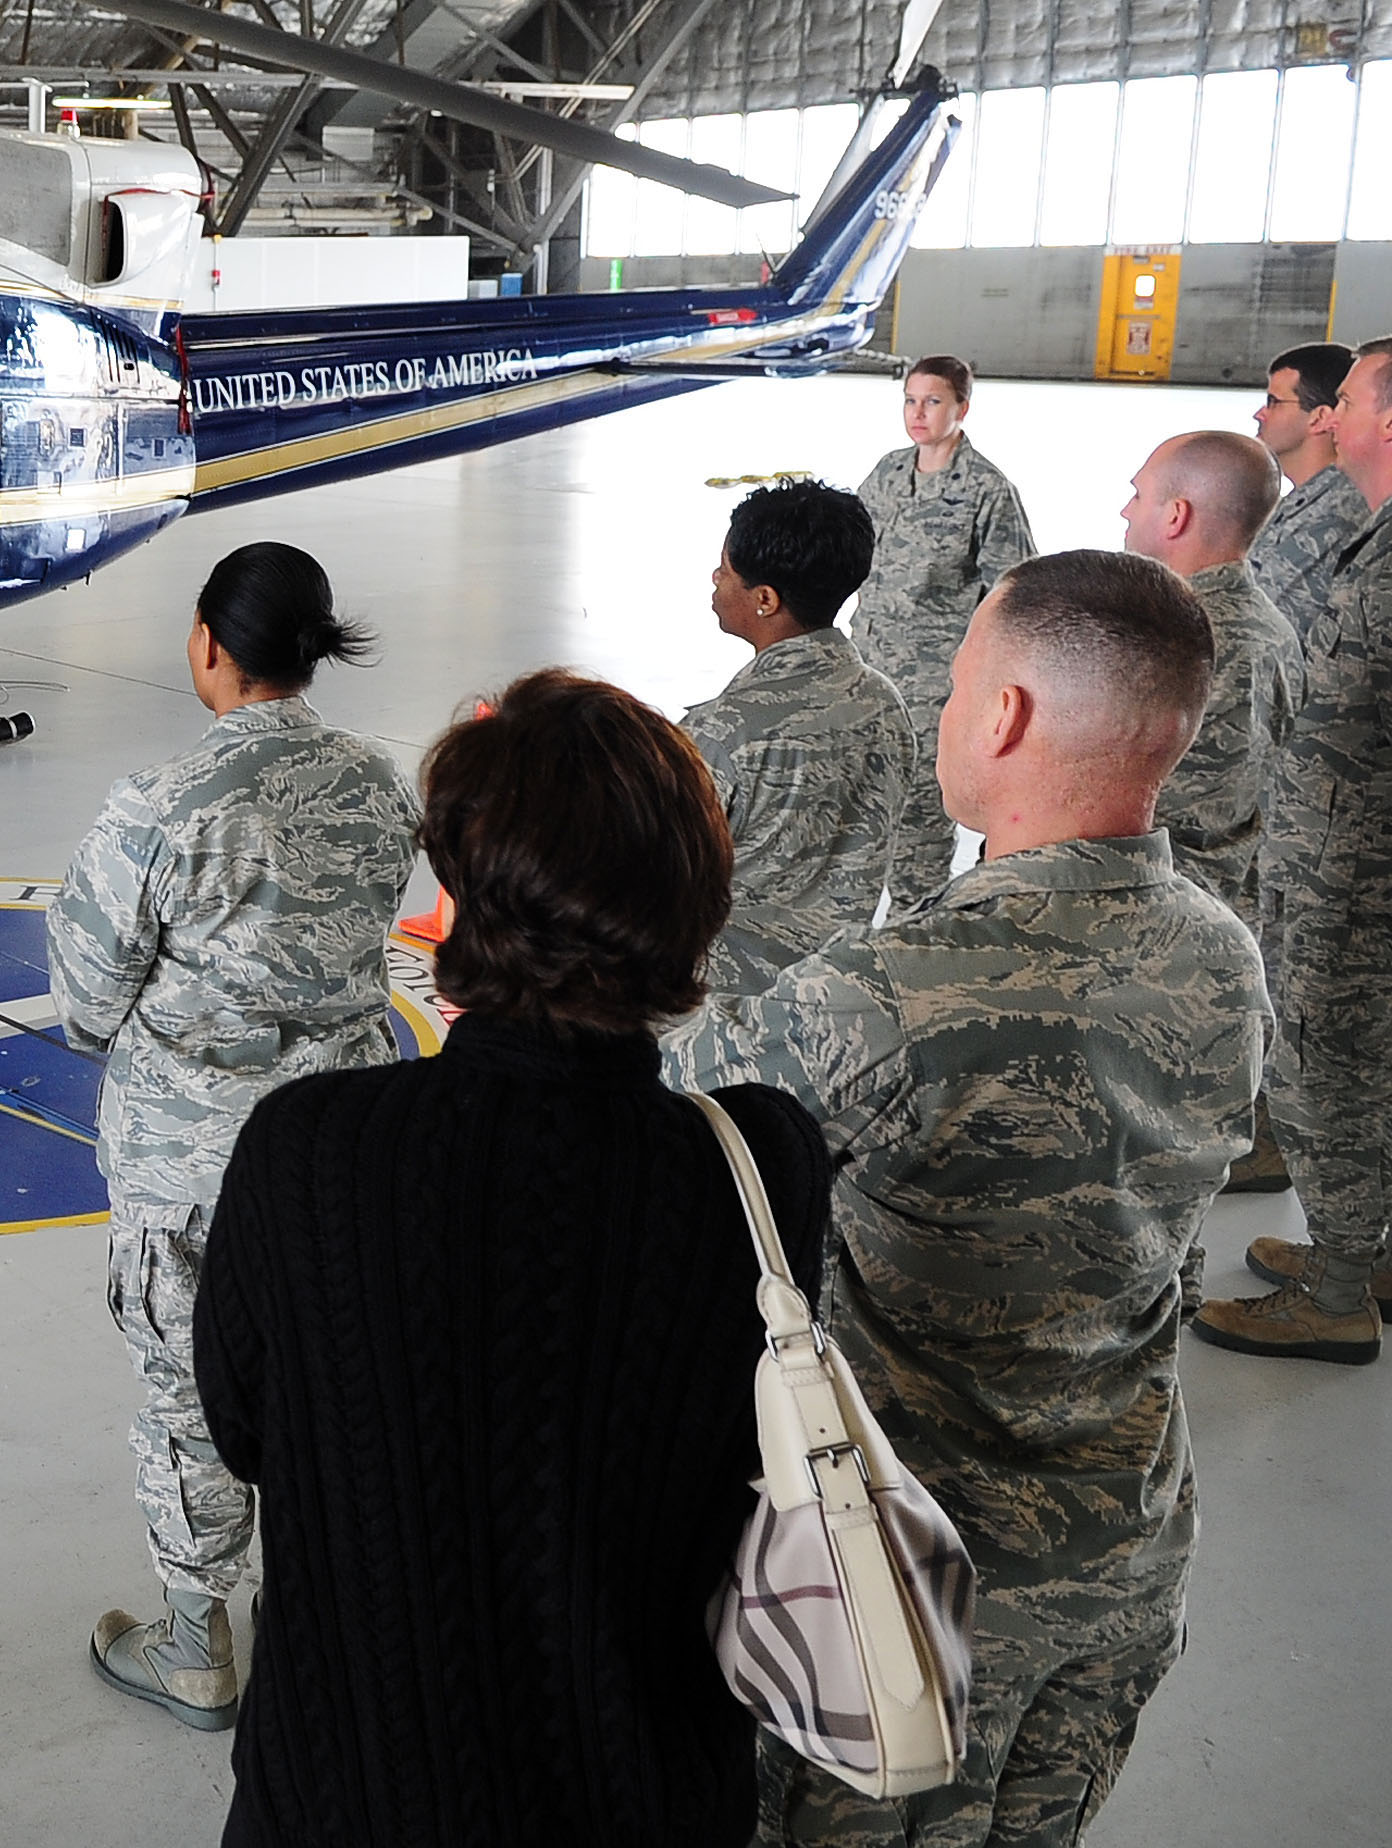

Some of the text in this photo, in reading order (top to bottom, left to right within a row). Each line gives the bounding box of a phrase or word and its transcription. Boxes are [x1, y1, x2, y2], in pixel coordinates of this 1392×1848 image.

[192, 348, 538, 413] UNITED STATES OF AMERICA
